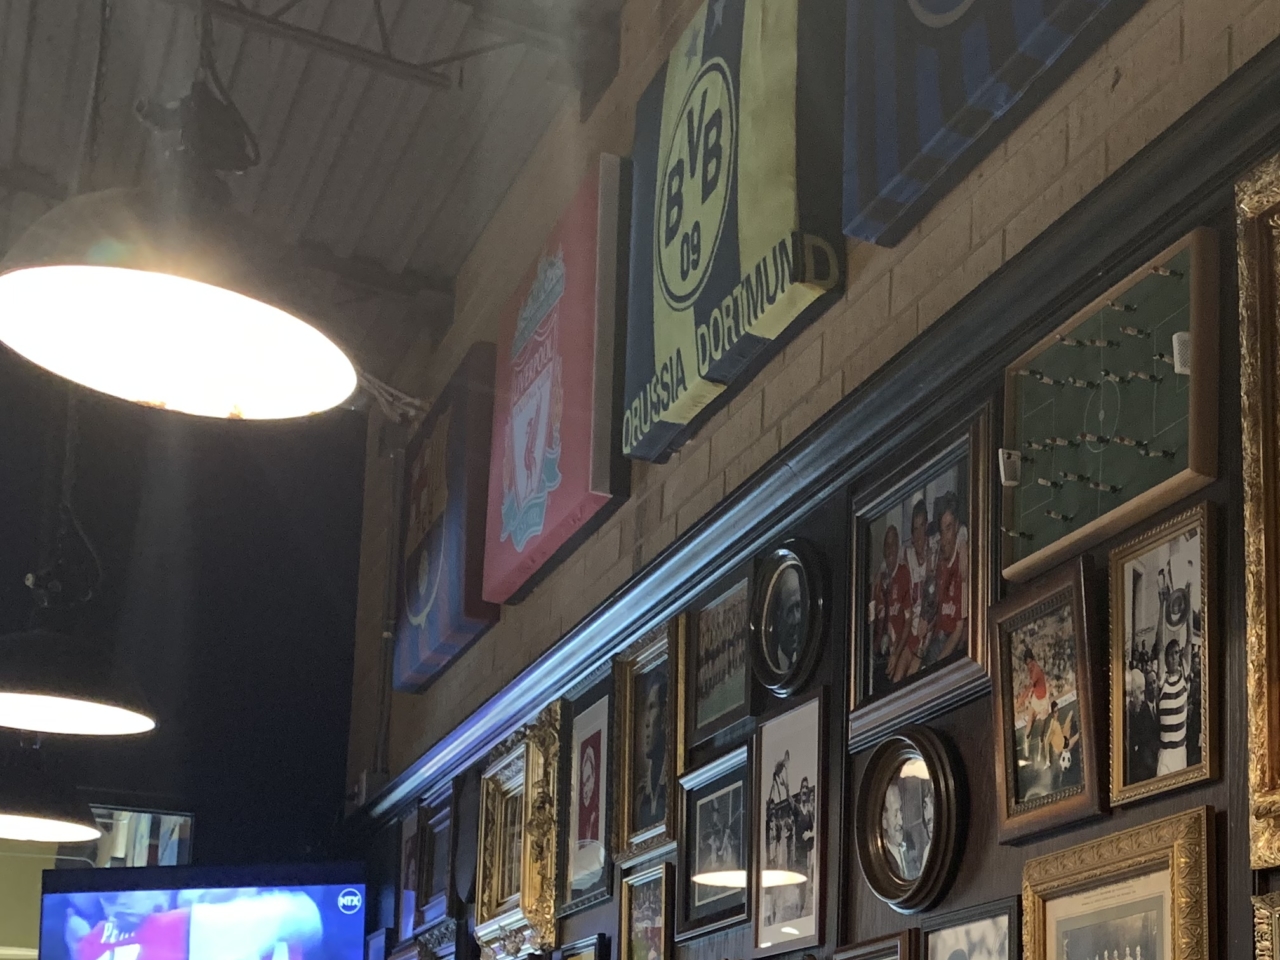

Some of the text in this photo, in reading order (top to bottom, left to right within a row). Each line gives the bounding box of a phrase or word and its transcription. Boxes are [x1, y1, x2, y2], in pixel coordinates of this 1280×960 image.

[664, 87, 723, 250] BVB
[680, 219, 701, 282] 09
[622, 347, 688, 454] ORUSSIA
[696, 231, 839, 377] DORTMUND
[339, 895, 361, 906] NTX
